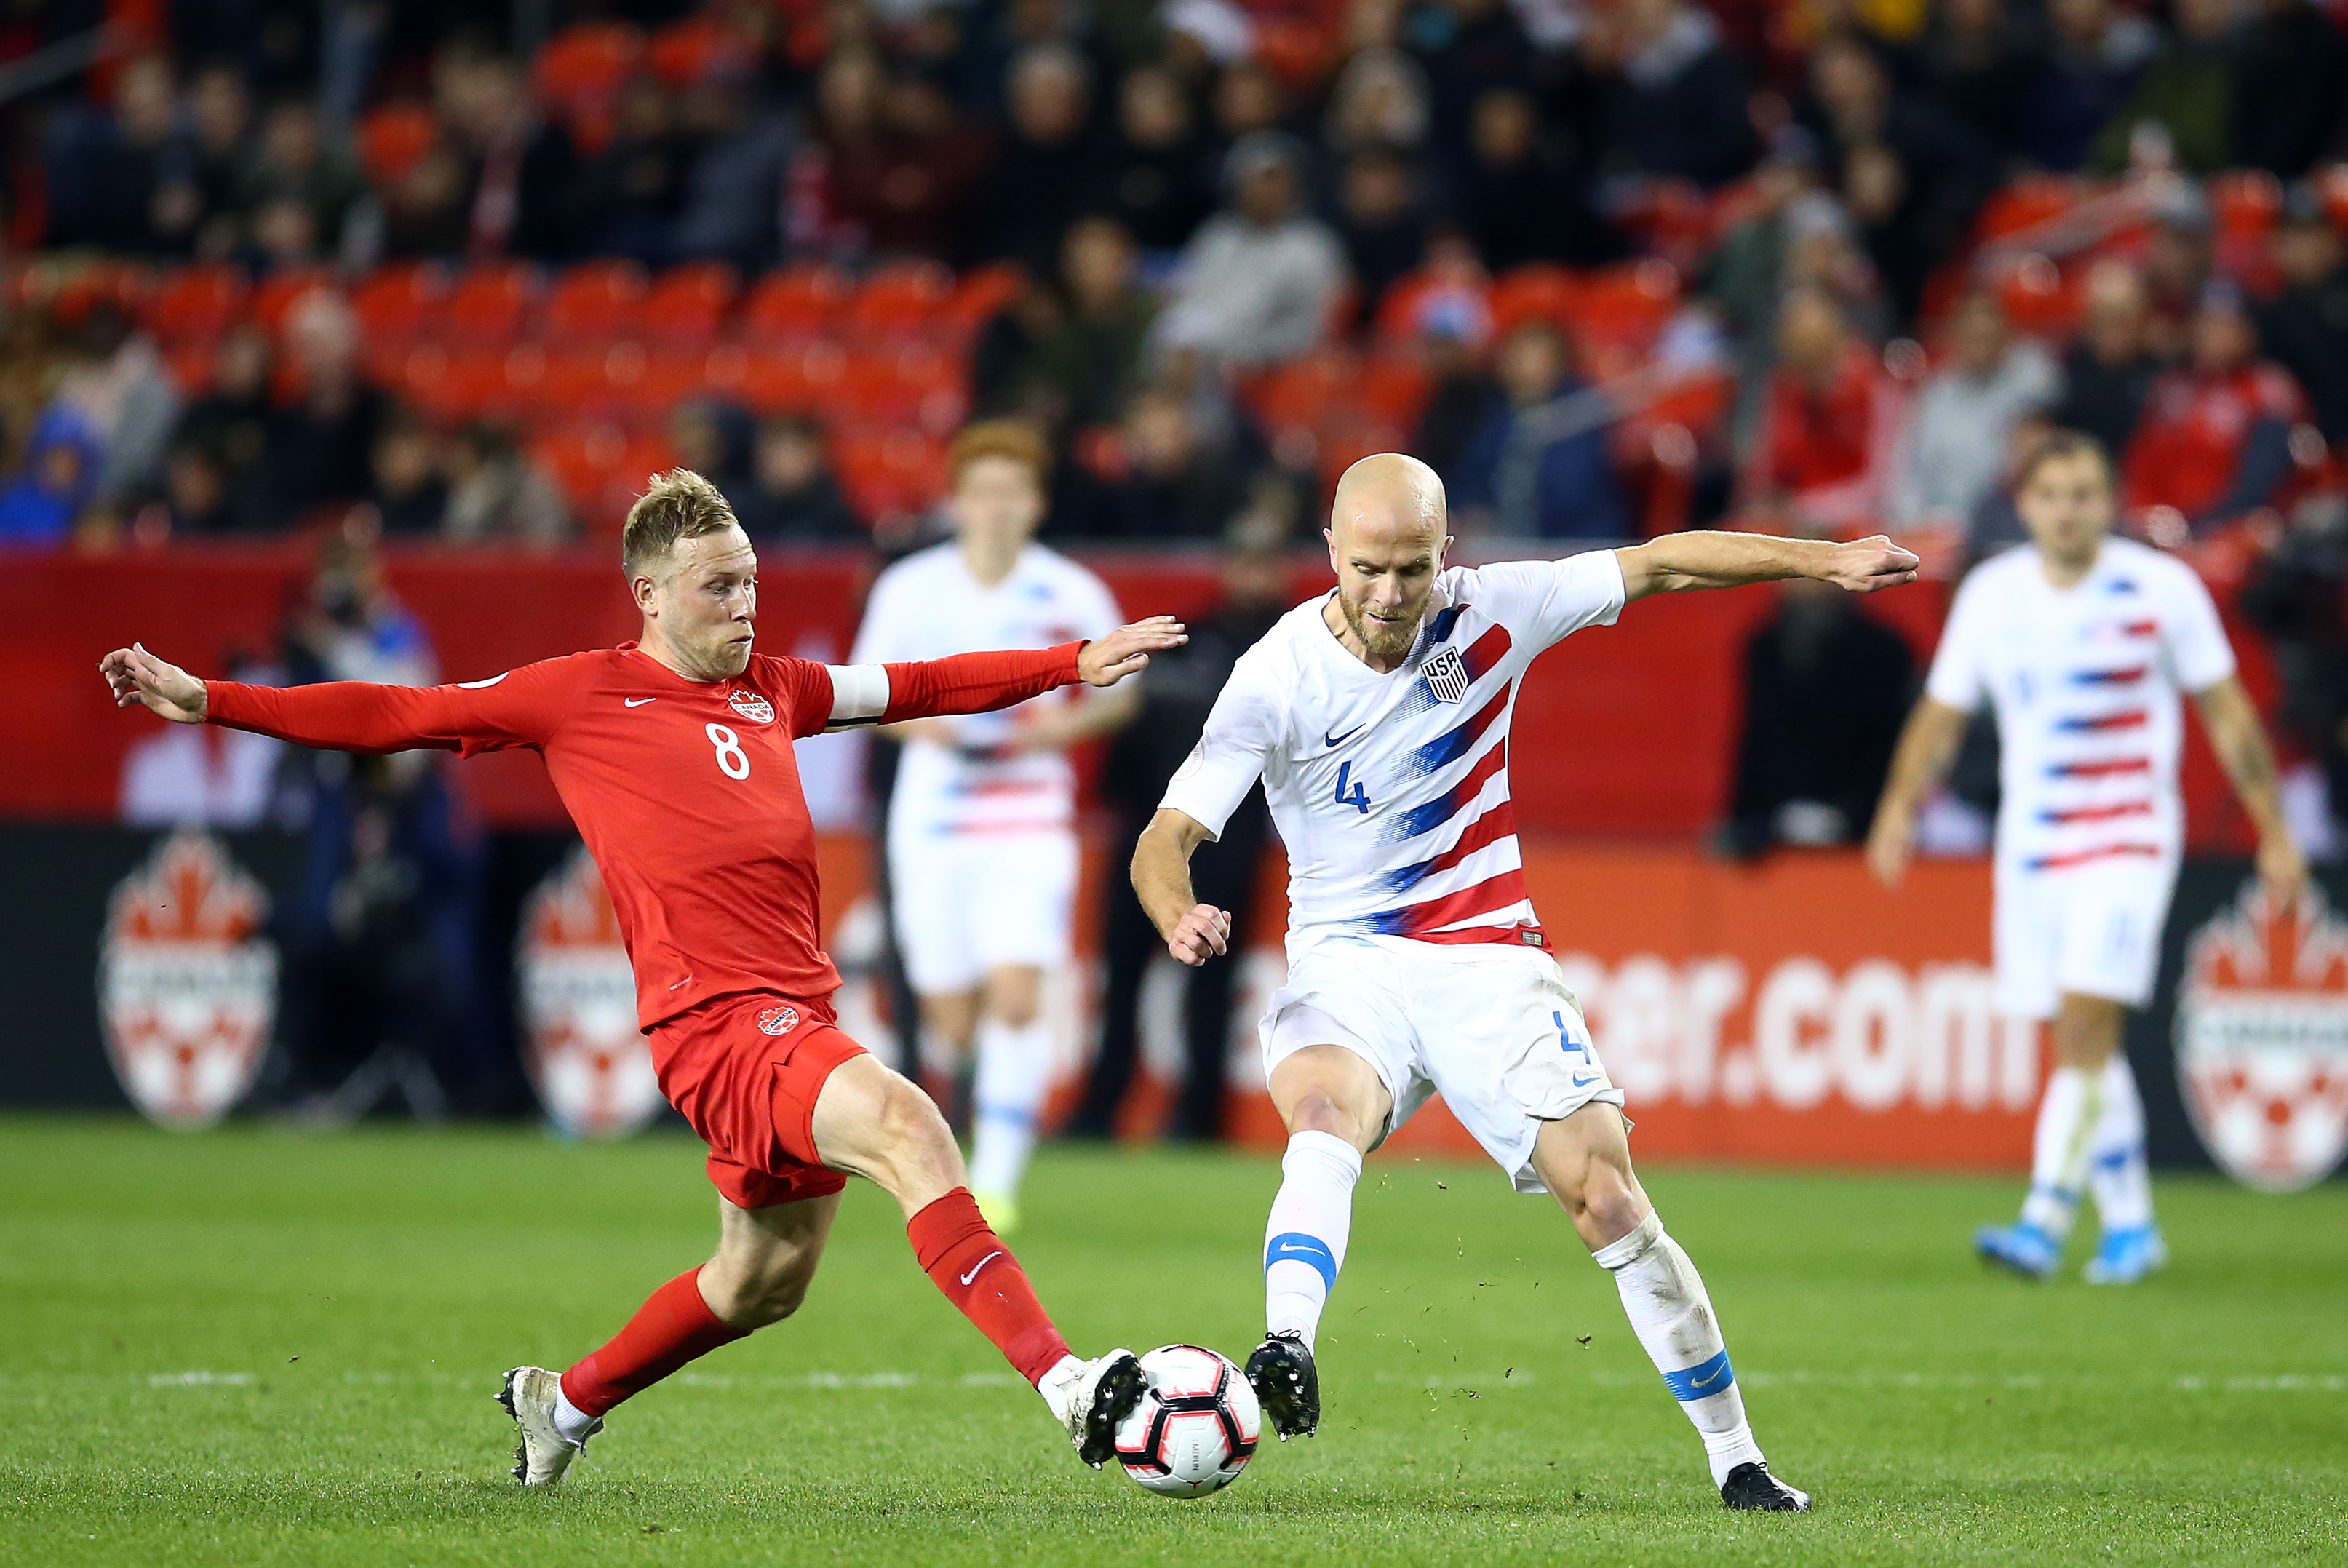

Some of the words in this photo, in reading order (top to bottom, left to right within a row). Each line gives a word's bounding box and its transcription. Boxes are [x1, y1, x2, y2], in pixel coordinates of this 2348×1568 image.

[1425, 650, 1457, 677] USA
[704, 722, 752, 781] 8
[1334, 760, 1372, 814] 4
[765, 1010, 793, 1033] CANADA
[1552, 1010, 1591, 1066] 4
